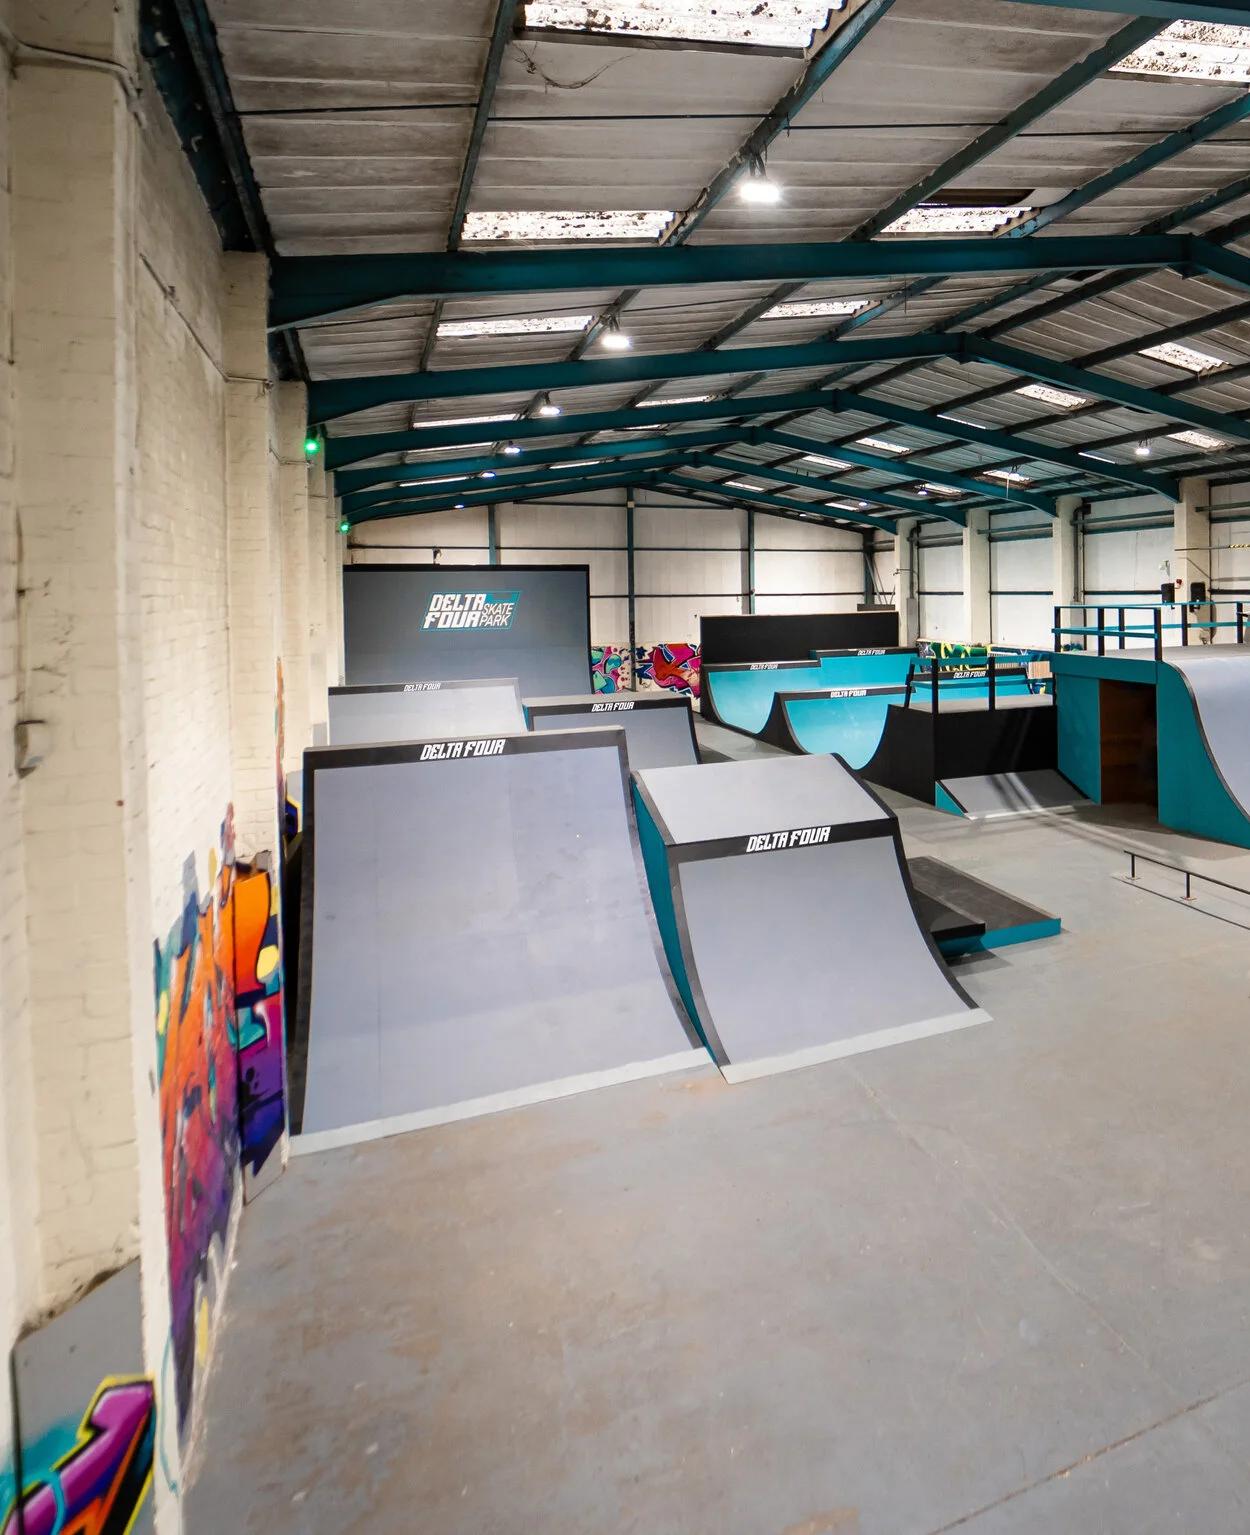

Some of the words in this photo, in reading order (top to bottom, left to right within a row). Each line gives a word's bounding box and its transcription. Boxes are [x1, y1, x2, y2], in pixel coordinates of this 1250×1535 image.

[429, 594, 487, 611] DELTA
[482, 602, 515, 615] SKATE
[423, 611, 481, 628] FOUR
[479, 614, 511, 627] PARK
[404, 684, 422, 692] DELTA
[422, 682, 441, 691] FOUR
[830, 690, 848, 698] DELTA
[848, 689, 867, 697] FOUR
[591, 703, 613, 712] DELTA
[613, 702, 635, 711] FOUR
[420, 742, 464, 760] DELTA
[463, 739, 506, 757] FOUR
[746, 833, 789, 853] DELTA
[789, 826, 831, 847] FOUR
